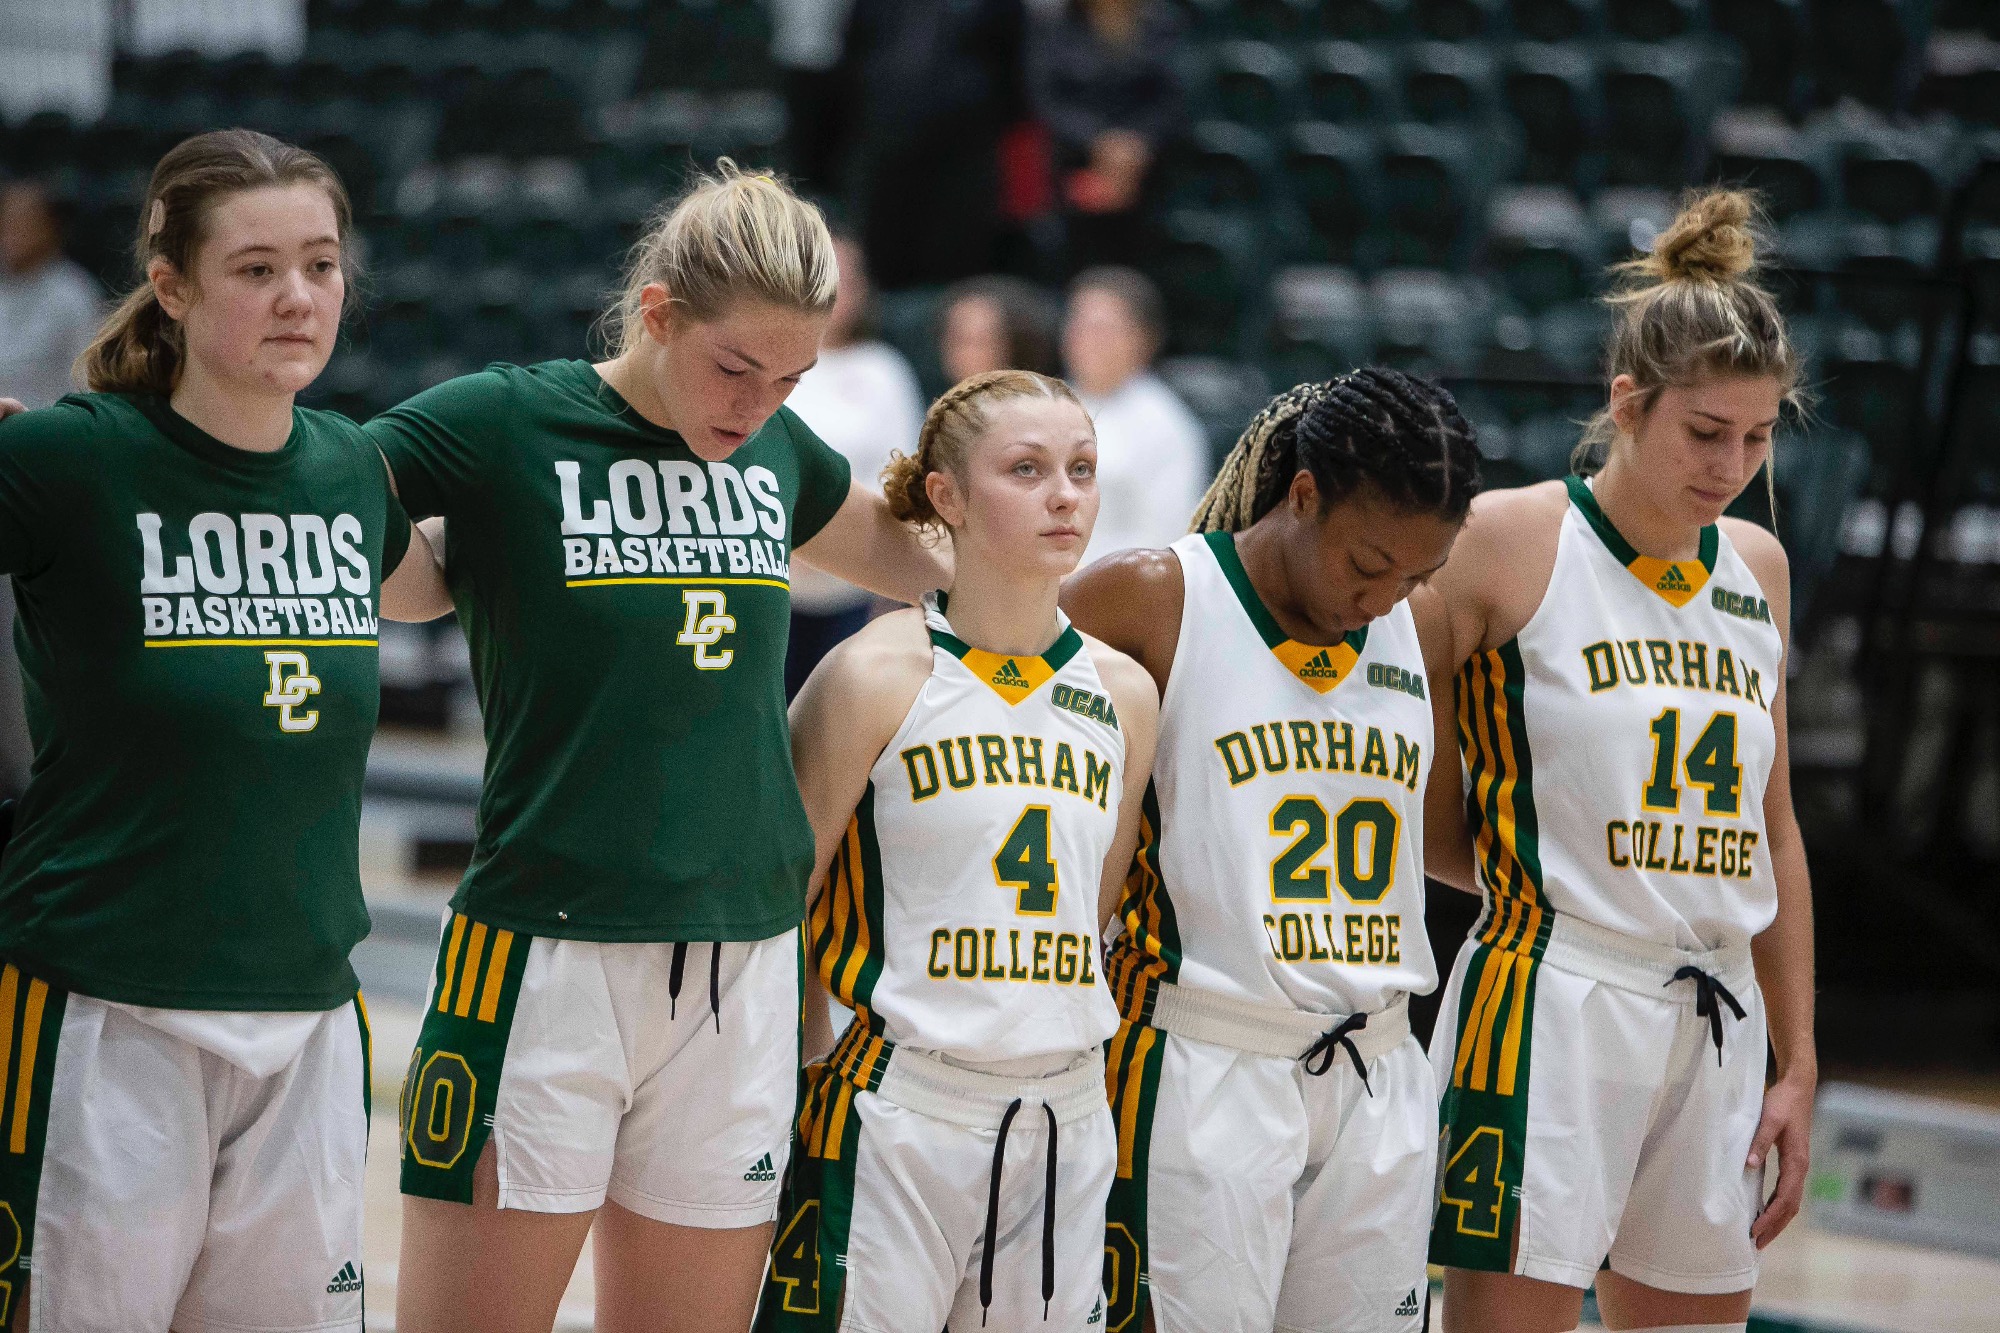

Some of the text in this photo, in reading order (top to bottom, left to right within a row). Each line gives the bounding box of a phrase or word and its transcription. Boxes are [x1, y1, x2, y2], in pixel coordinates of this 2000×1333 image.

[554, 459, 787, 541] LORDS
[136, 512, 371, 596] LORDS
[562, 537, 790, 581] BASKETBALL
[142, 596, 378, 636] BASKETBALL
[1656, 580, 1692, 592] adidas
[1711, 586, 1771, 626] OCAA
[992, 676, 1029, 689] adidas
[1299, 667, 1338, 679] adidas
[1366, 662, 1426, 701] OCAA
[1581, 639, 1768, 713] DURHAM
[1051, 682, 1119, 731] OCAA
[900, 733, 1112, 812] DURHAM
[1214, 720, 1422, 794] DURHAM
[1641, 707, 1743, 818] 14
[991, 804, 1059, 917] 4
[1268, 794, 1401, 905] 20
[1606, 819, 1760, 881] COLLEGE
[926, 927, 1096, 987] COLLEGE
[1262, 911, 1402, 966] COLLEGE
[399, 1047, 477, 1169] 0
[743, 1170, 776, 1182] adidas
[1431, 1124, 1505, 1239] 4
[326, 1280, 362, 1293] adidas
[771, 1199, 821, 1314] 4
